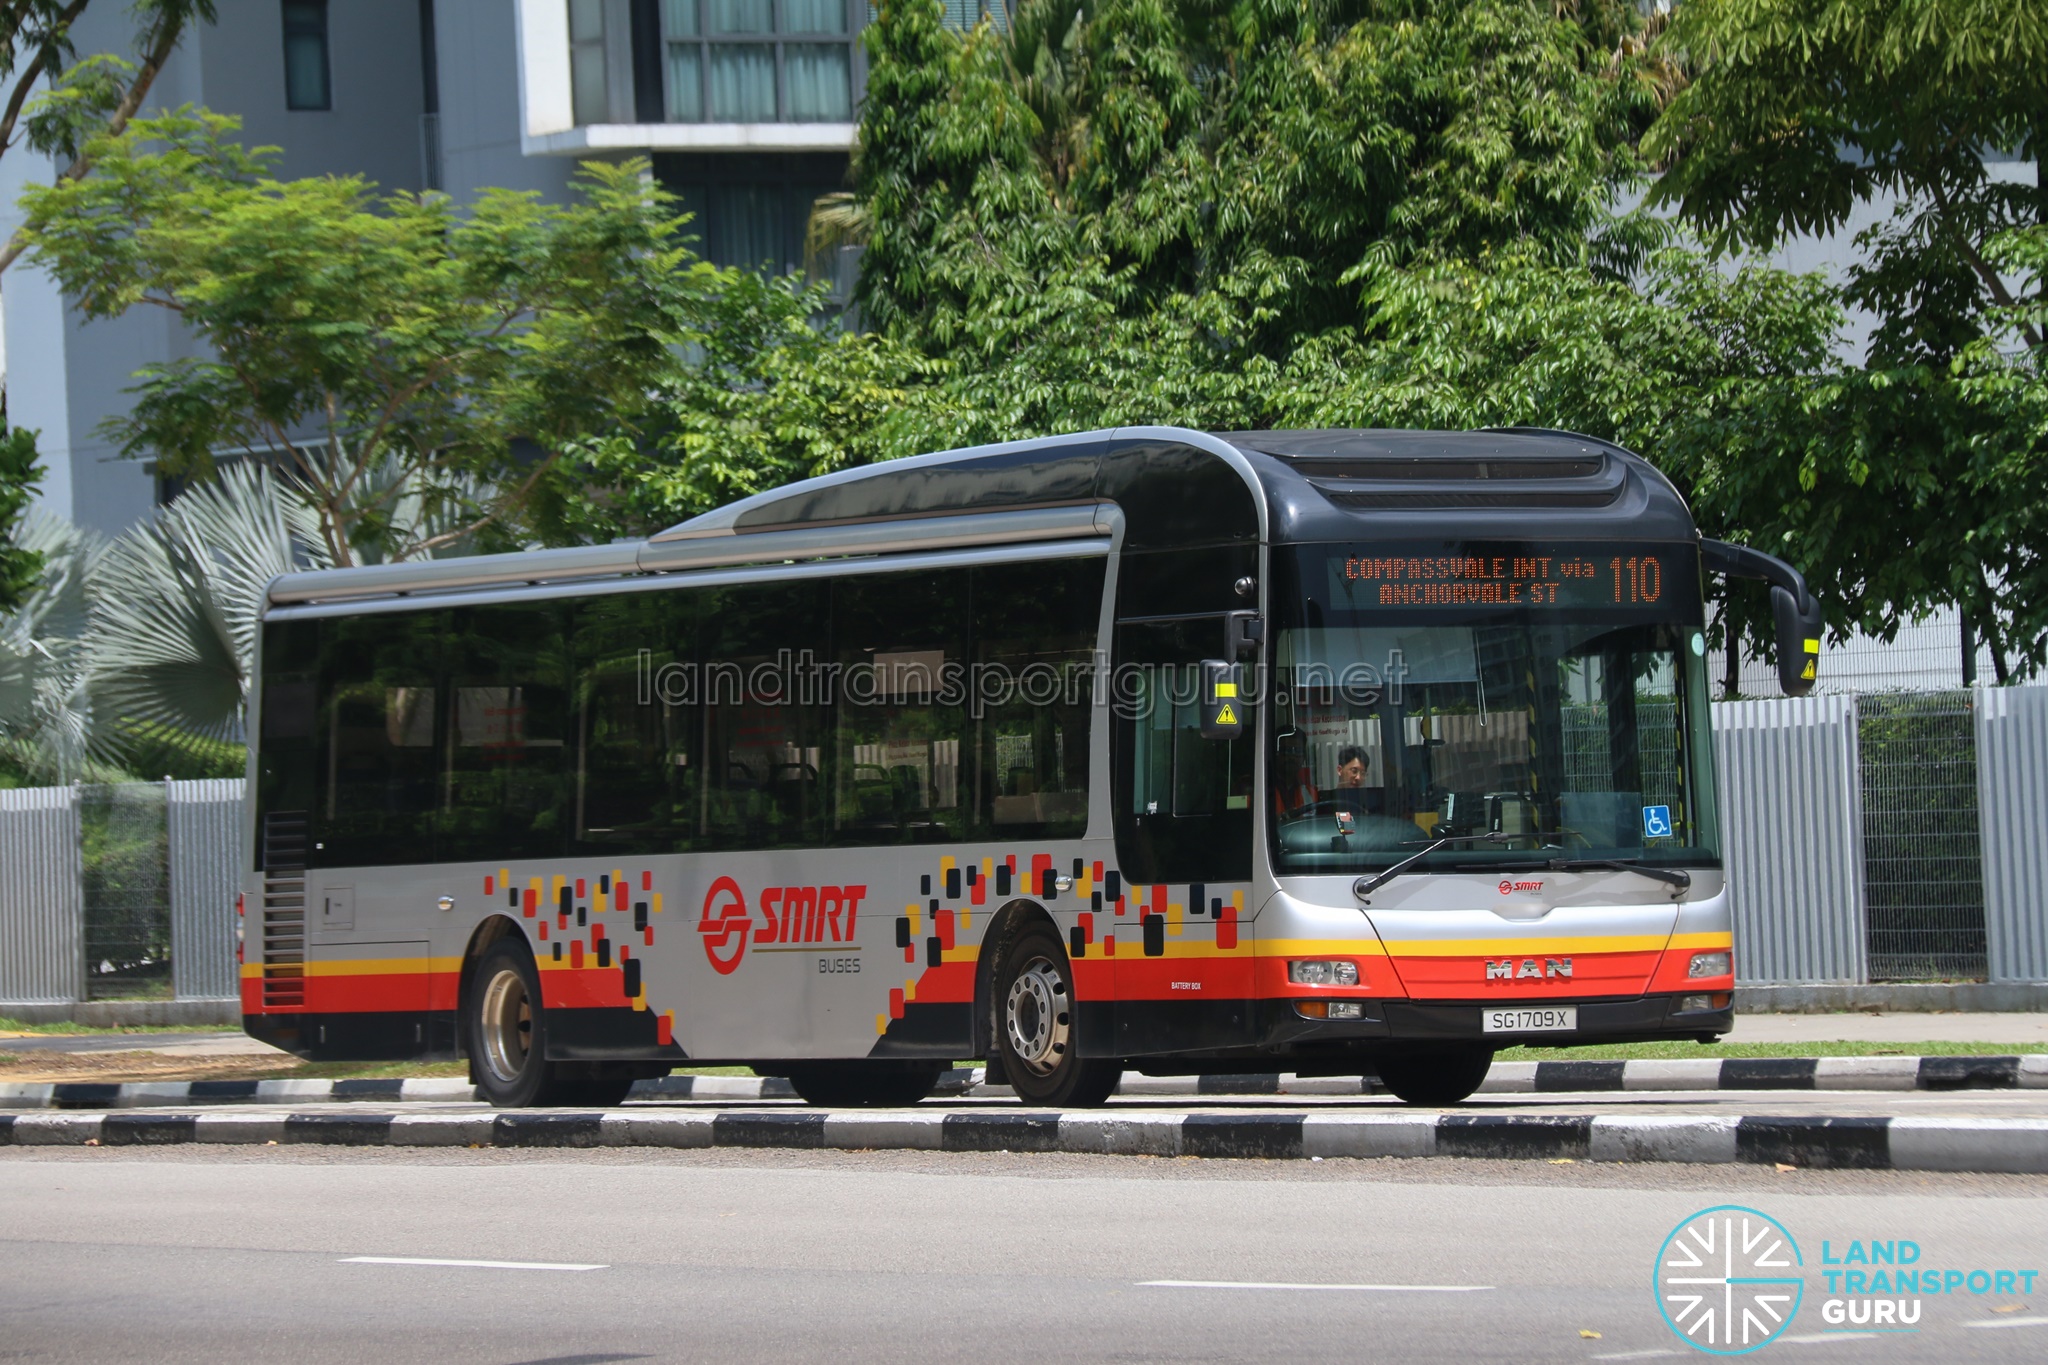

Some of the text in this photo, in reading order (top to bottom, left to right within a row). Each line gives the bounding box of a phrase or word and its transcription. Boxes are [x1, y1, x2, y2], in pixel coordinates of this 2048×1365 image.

[1345, 557, 1595, 580] COMPASSVALE INT via
[1609, 556, 1661, 603] 110
[1379, 582, 1560, 605] ANCHORVALE ST
[1513, 881, 1544, 891] SMRT
[753, 885, 867, 943] SMRT
[818, 958, 861, 974] BUSES
[1485, 957, 1573, 980] MAN
[1171, 981, 1202, 990] BATTERY BOX
[1492, 1010, 1567, 1029] SG1709X
